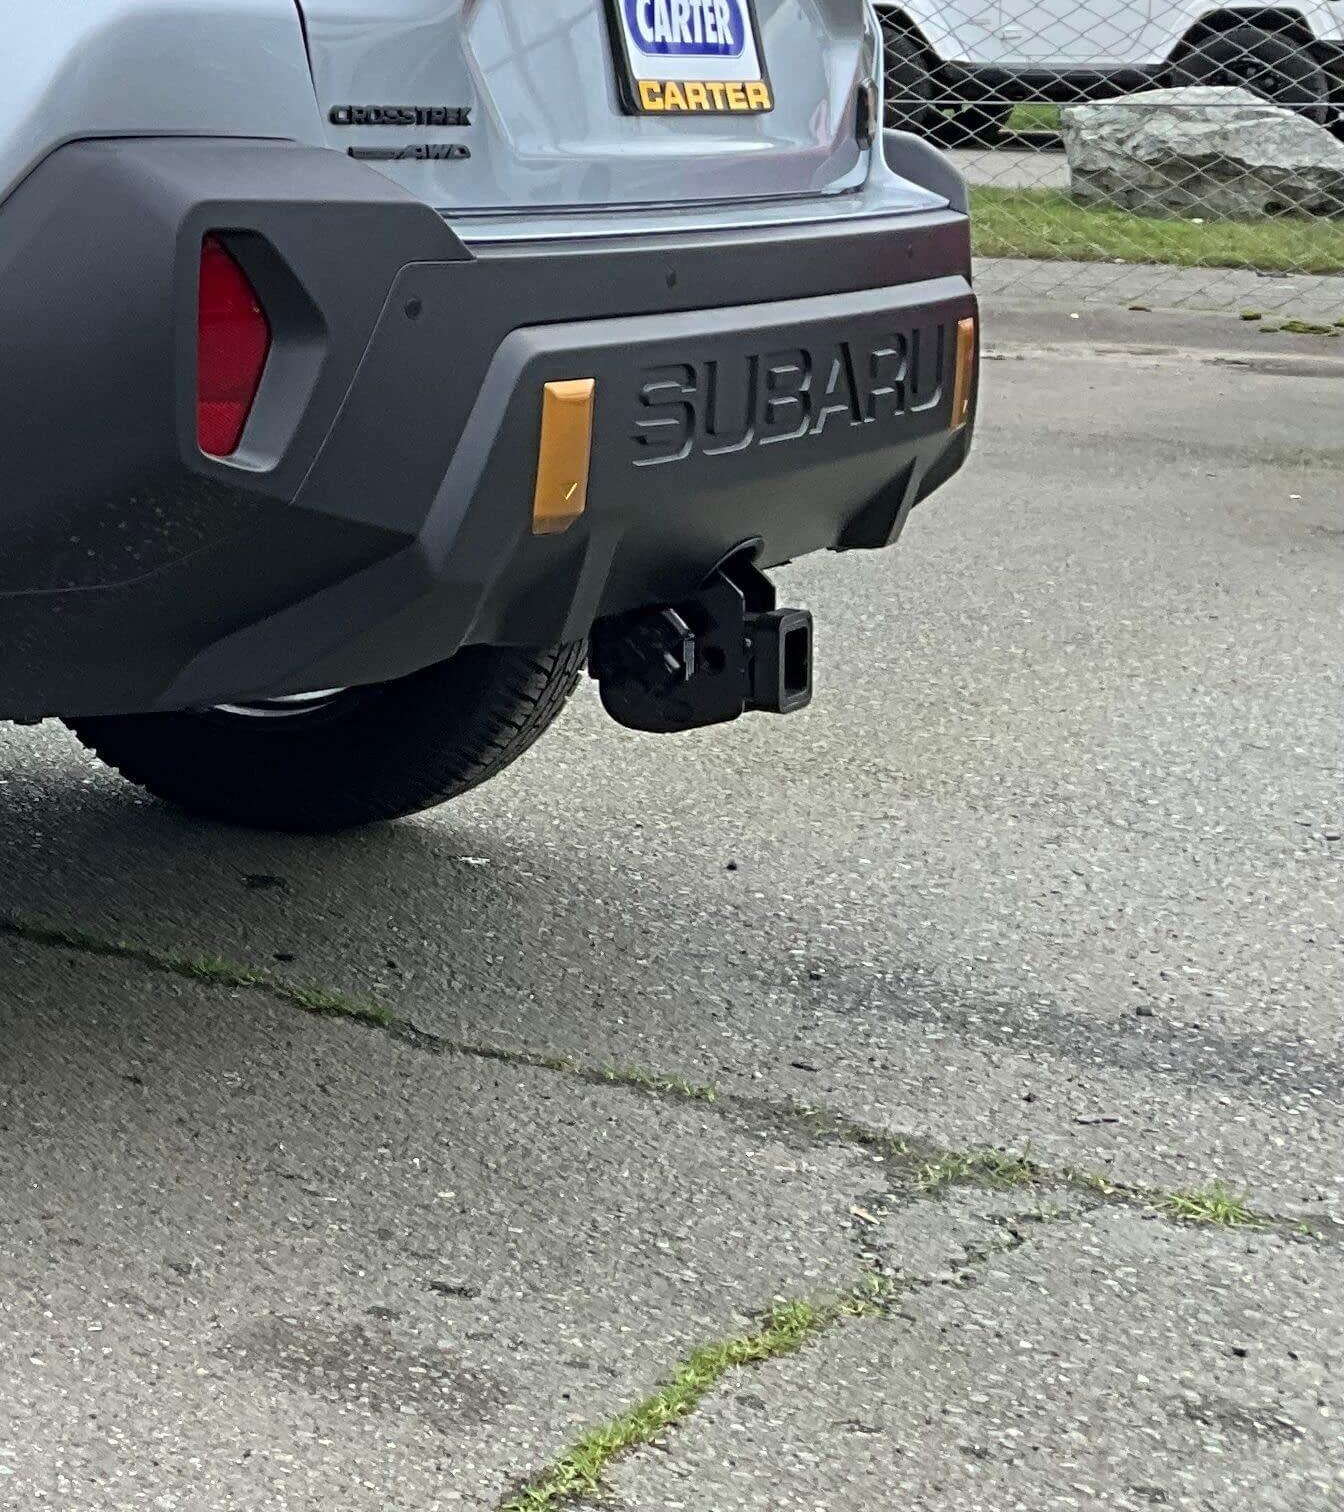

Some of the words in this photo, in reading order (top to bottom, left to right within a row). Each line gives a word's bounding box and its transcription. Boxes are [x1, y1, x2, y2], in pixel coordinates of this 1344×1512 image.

[638, 80, 771, 110] CARTER
[329, 106, 472, 125] CROSSTREK
[631, 324, 945, 466] SUBARU
